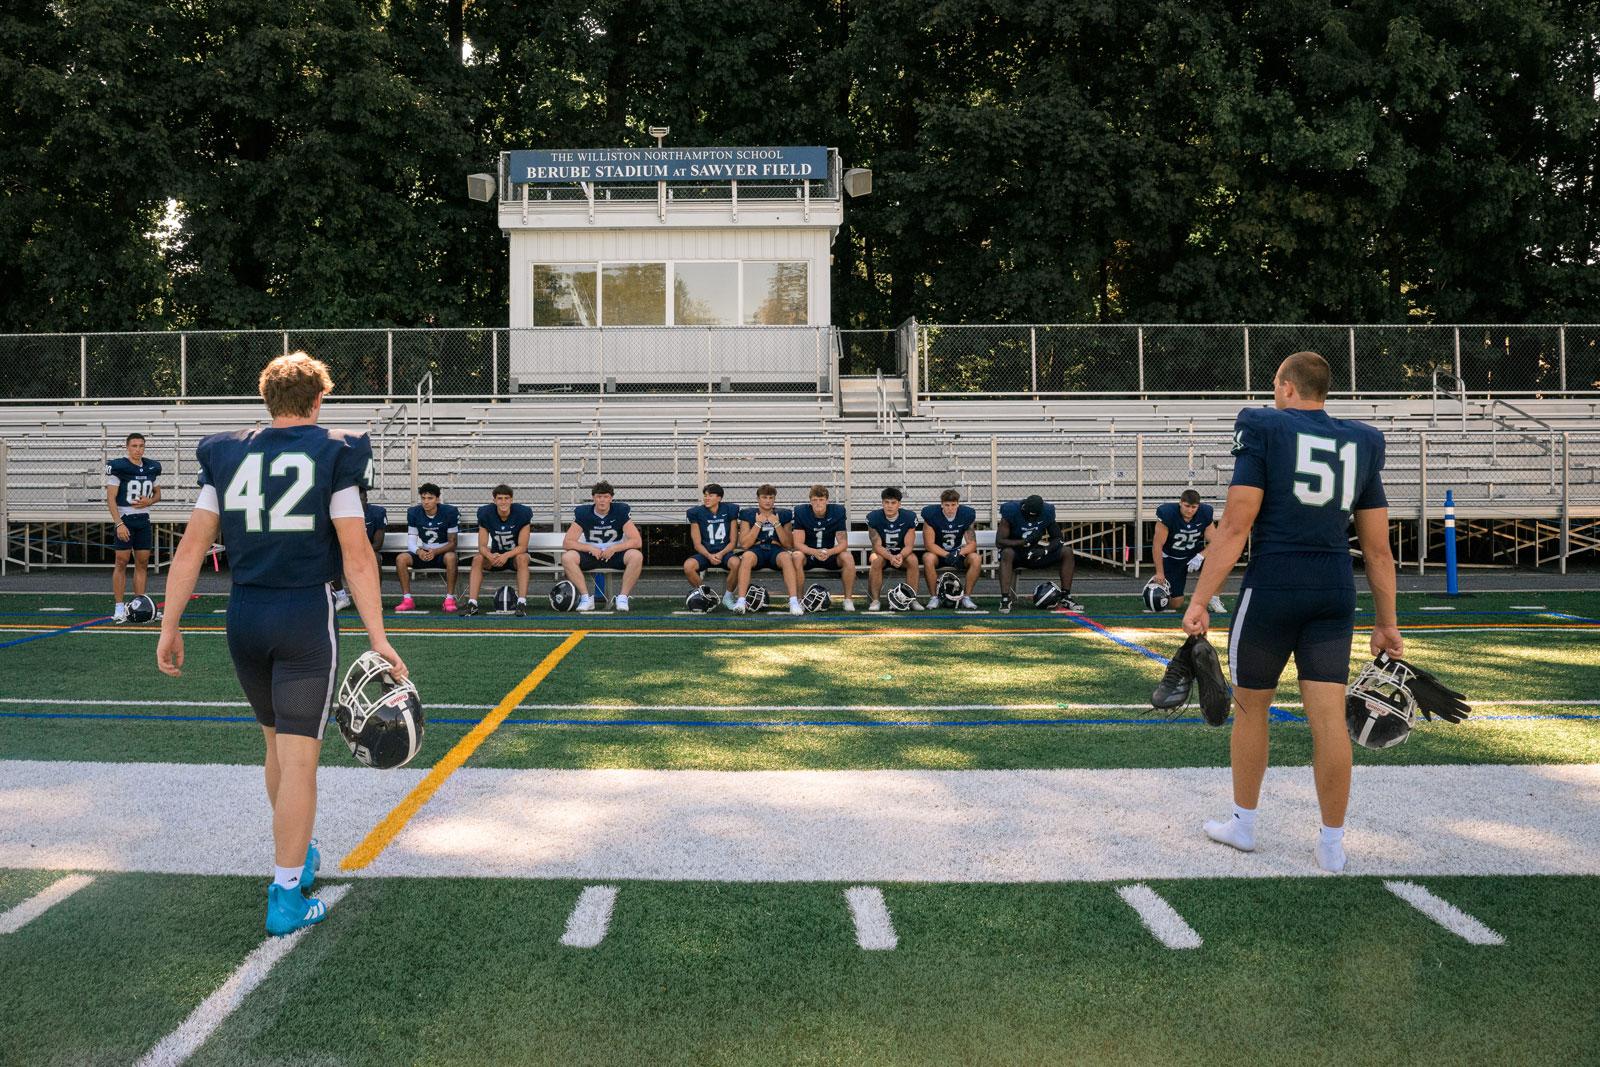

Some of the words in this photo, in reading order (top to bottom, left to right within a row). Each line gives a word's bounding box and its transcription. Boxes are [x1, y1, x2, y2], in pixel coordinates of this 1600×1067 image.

[551, 153, 574, 162] THE
[577, 152, 641, 161] WILLISTON
[644, 151, 733, 161] NORTHAMPTON
[736, 150, 784, 160] SCHOOL
[526, 166, 591, 179] BERUBE
[595, 165, 669, 178] STADIUM
[672, 168, 687, 177] AT
[690, 164, 758, 177] SAWYER
[762, 163, 812, 176] FIELD
[1293, 432, 1358, 511] 51
[126, 480, 154, 504] 80
[224, 452, 315, 532] 42
[425, 530, 439, 545] 2
[494, 534, 516, 551] 15
[590, 529, 618, 544] 52
[707, 523, 727, 545] 14
[815, 531, 823, 548] 1
[942, 533, 956, 550] 3
[1172, 532, 1201, 550] 25
